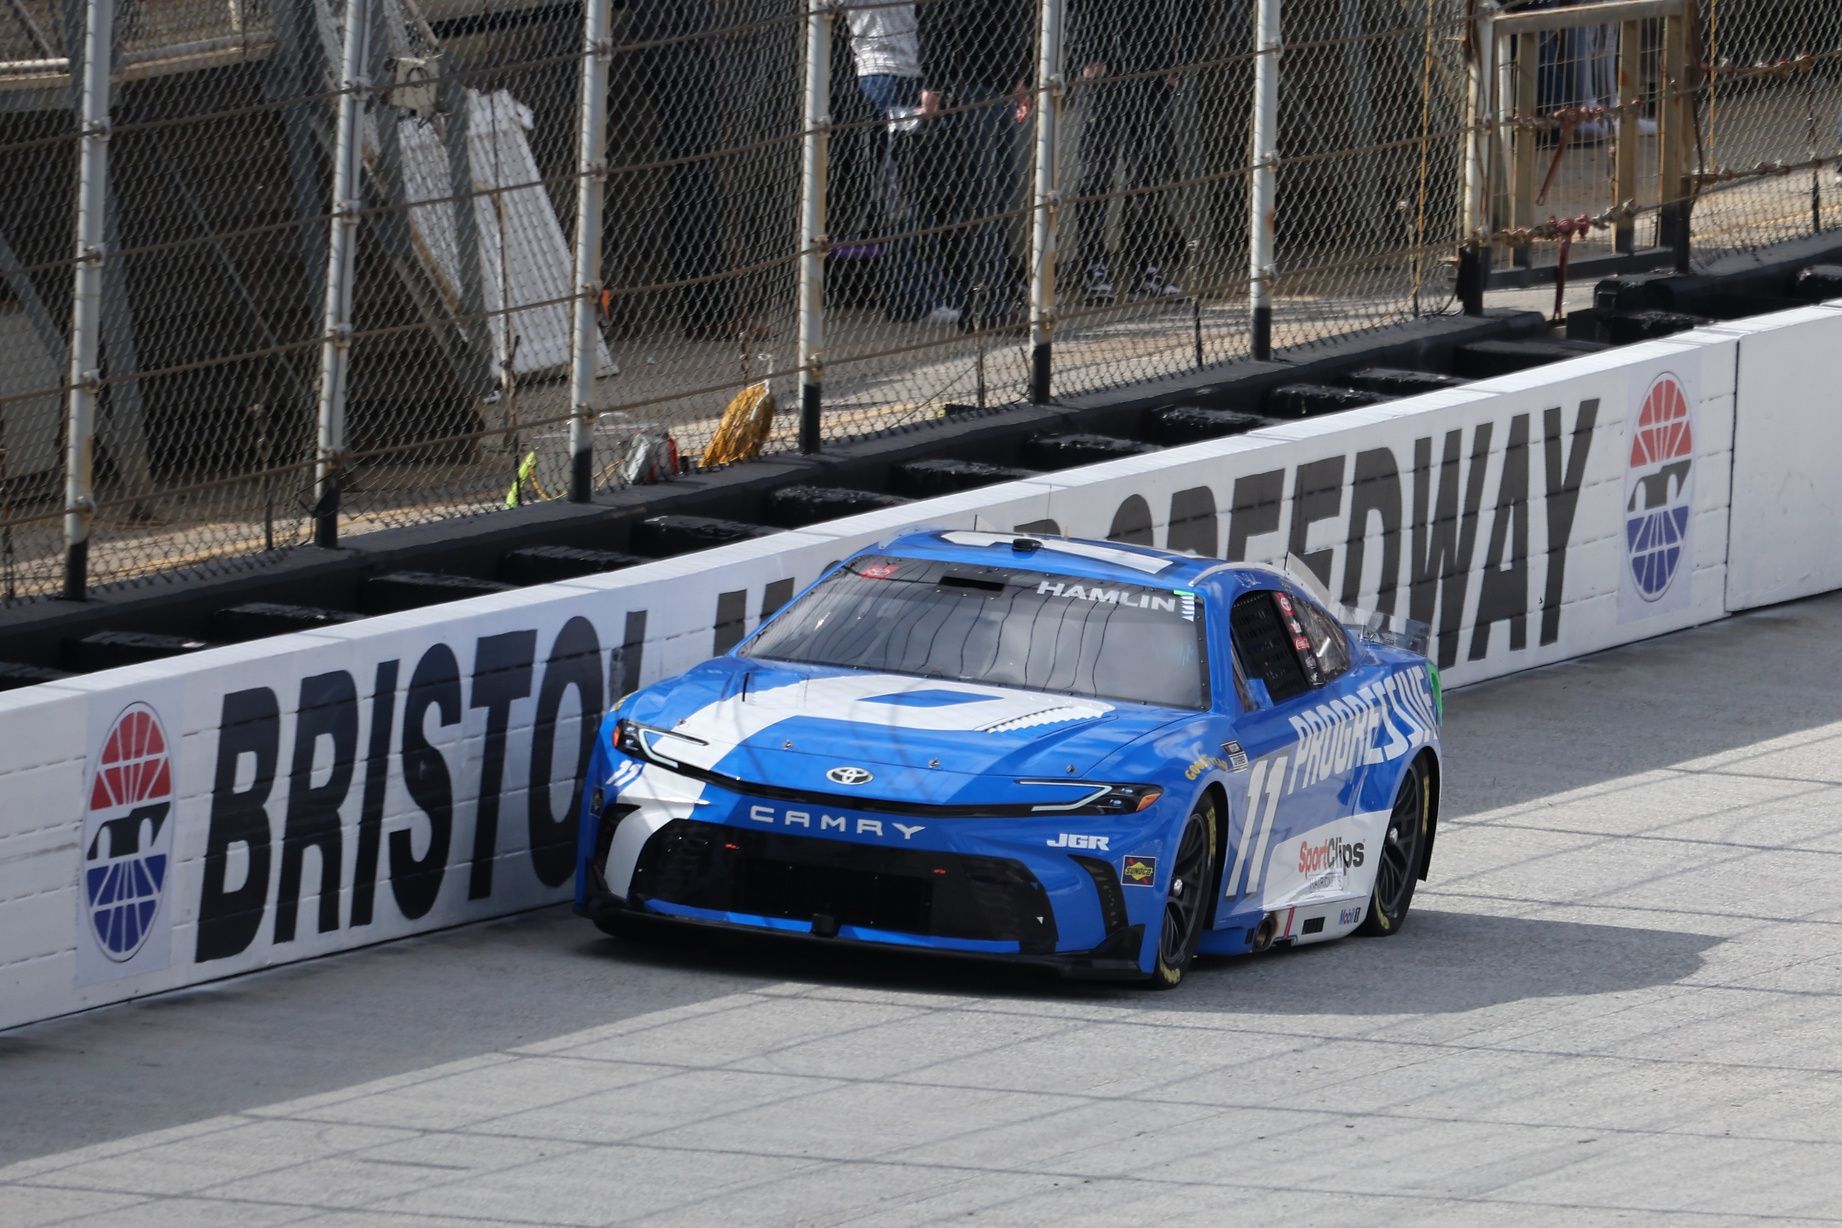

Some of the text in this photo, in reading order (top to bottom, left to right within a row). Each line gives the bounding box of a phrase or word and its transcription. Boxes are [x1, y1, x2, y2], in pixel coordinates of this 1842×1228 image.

[1036, 581, 1176, 612] HAMLIN
[1288, 666, 1438, 796] PROGRESSIVE
[606, 760, 642, 786] 11
[750, 805, 926, 840] CAMRY
[1226, 756, 1288, 897] 11
[1046, 833, 1110, 851] JGR
